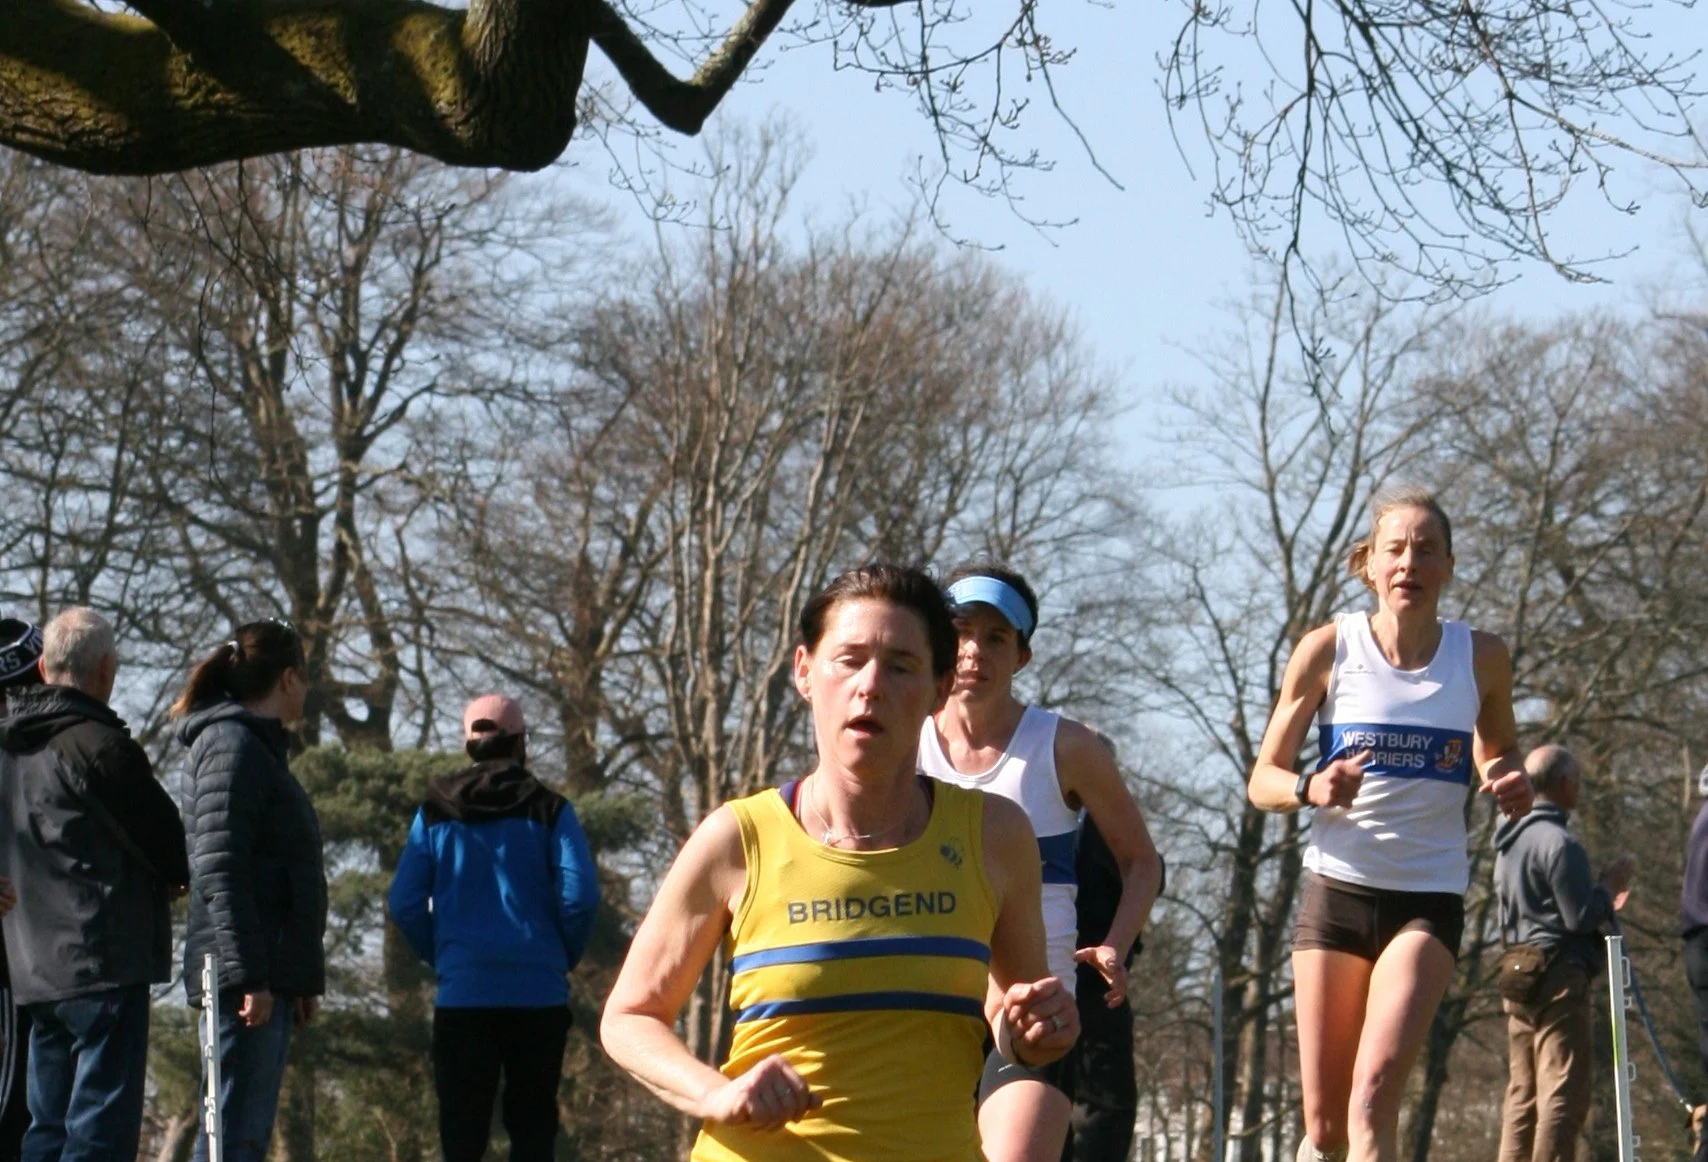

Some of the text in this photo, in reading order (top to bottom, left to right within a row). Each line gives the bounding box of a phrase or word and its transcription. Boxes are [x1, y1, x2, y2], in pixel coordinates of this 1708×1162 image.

[1342, 732, 1433, 750] WESTBURY
[1346, 749, 1425, 768] HRIERS
[788, 892, 956, 924] BRIDGEND
